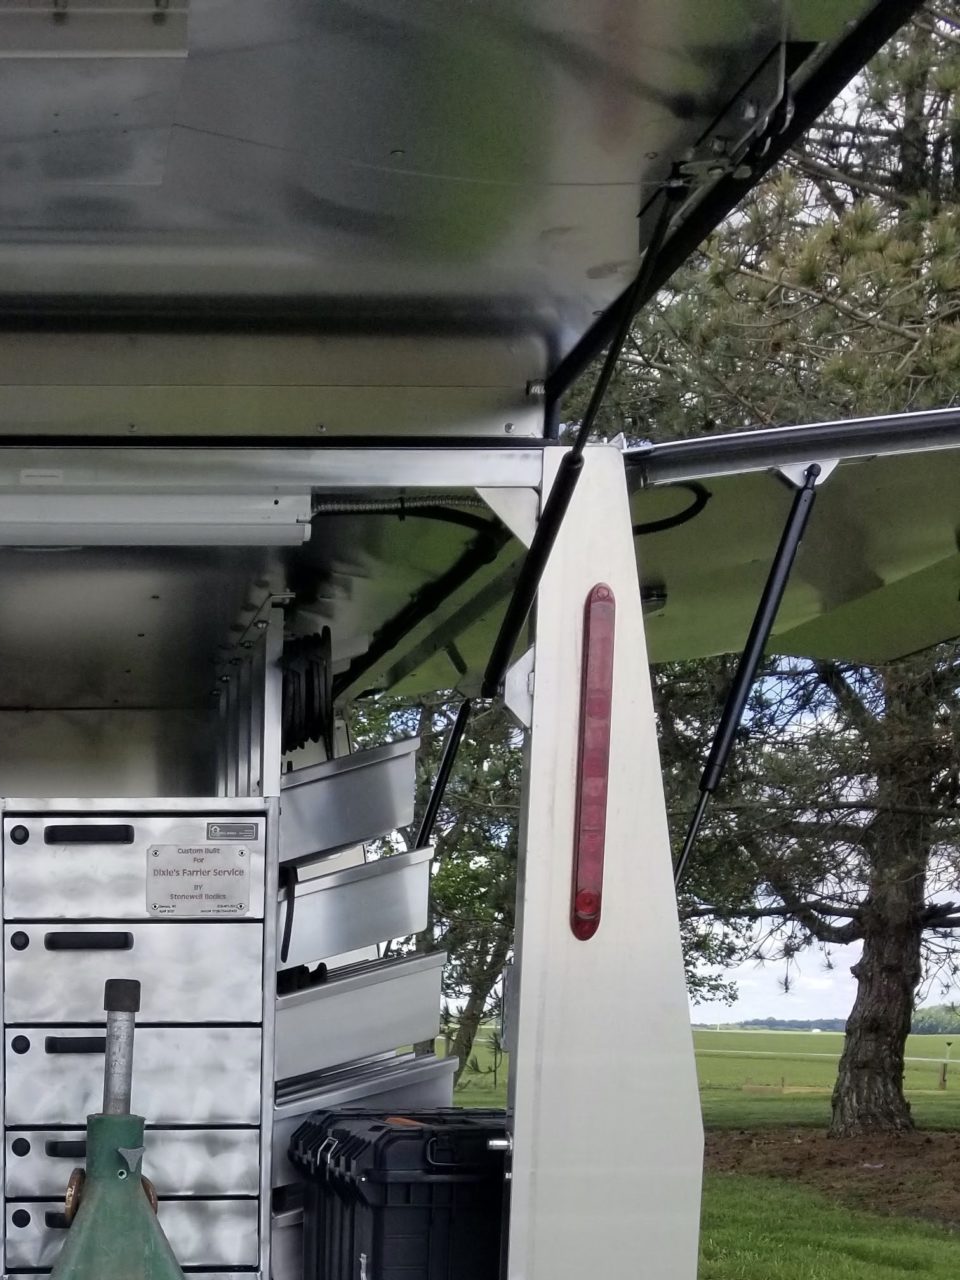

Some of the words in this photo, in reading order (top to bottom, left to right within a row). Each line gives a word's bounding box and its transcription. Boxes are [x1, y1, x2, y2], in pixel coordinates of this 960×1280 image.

[153, 868, 180, 877] Dixie's
[182, 868, 211, 877] Farrier
[213, 868, 245, 877] Service
